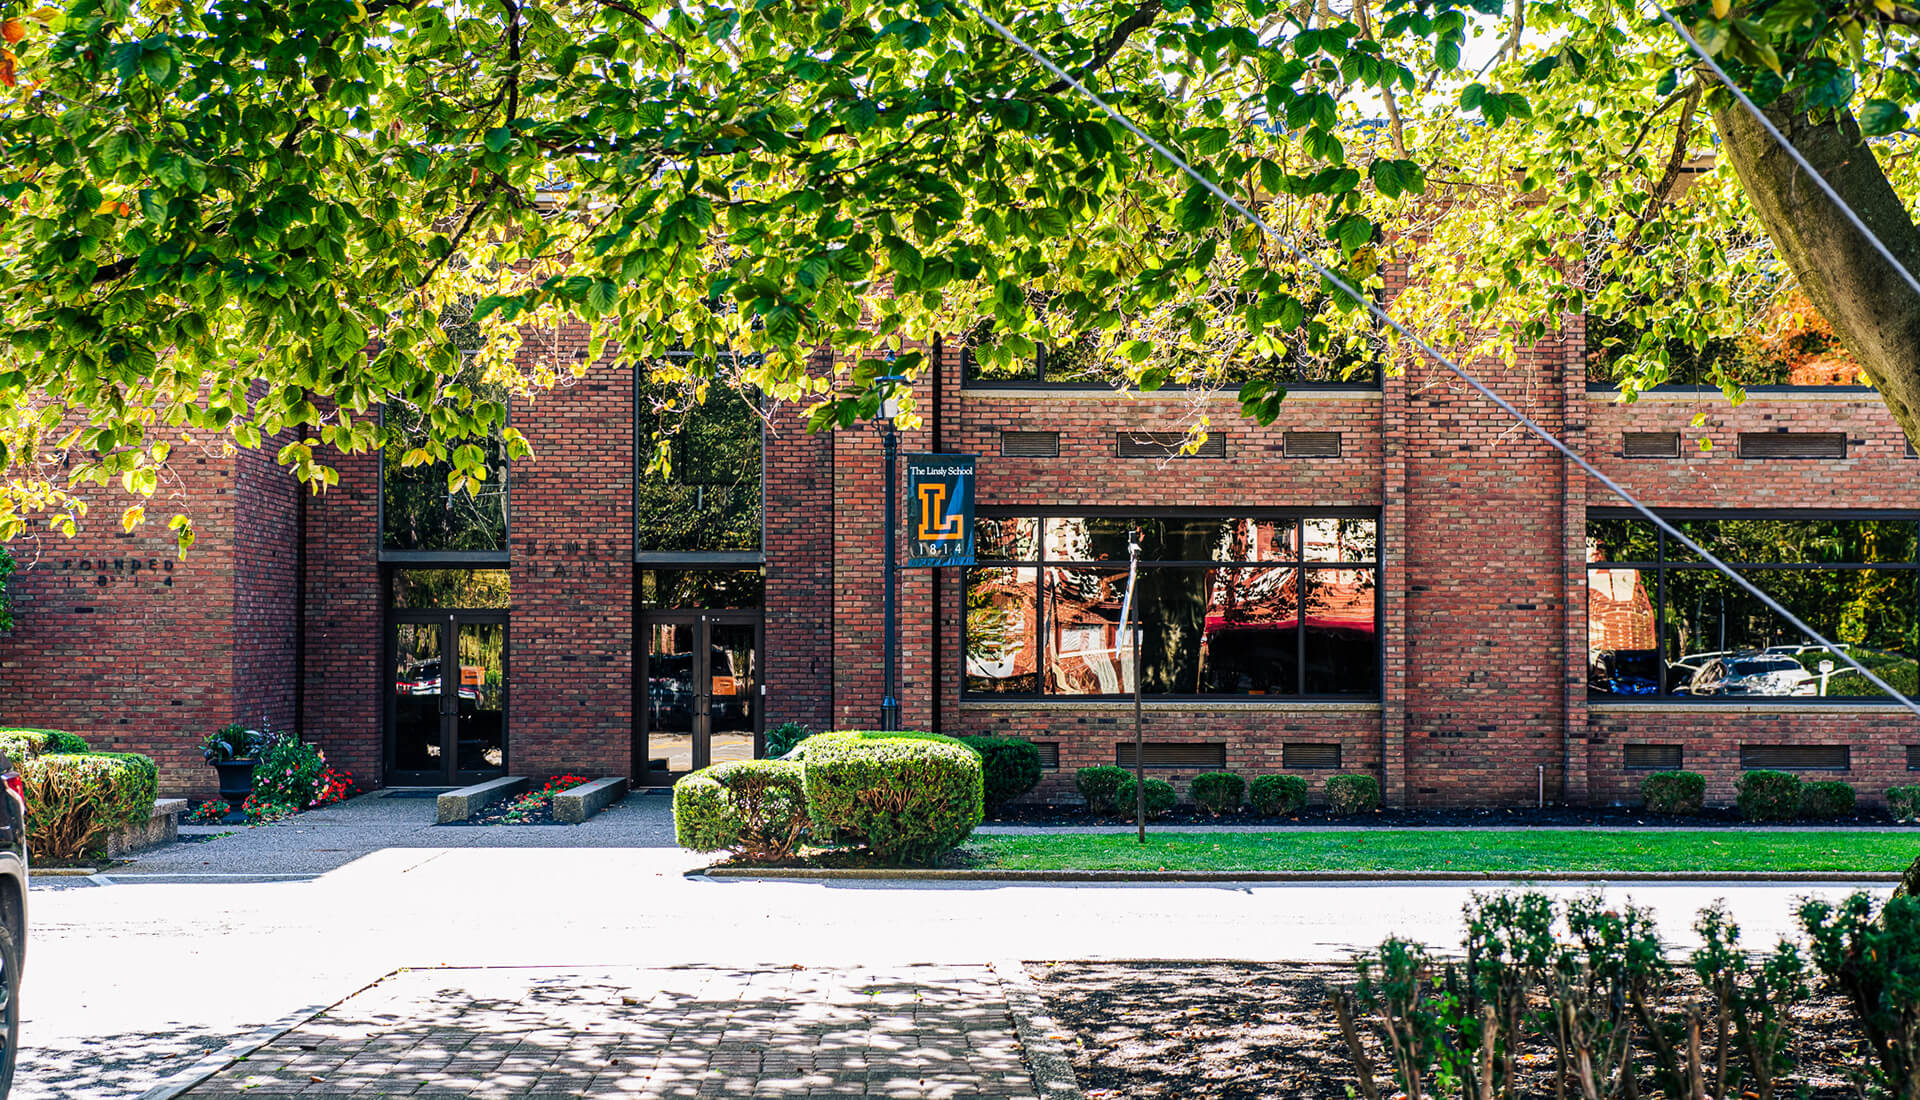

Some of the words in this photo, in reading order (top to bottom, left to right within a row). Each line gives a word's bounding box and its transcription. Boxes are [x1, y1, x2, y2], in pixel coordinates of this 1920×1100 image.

[910, 466, 926, 476] The
[926, 466, 947, 478] Linsly
[947, 466, 973, 476] School
[918, 483, 963, 540] L
[64, 559, 174, 571] FOUNDED
